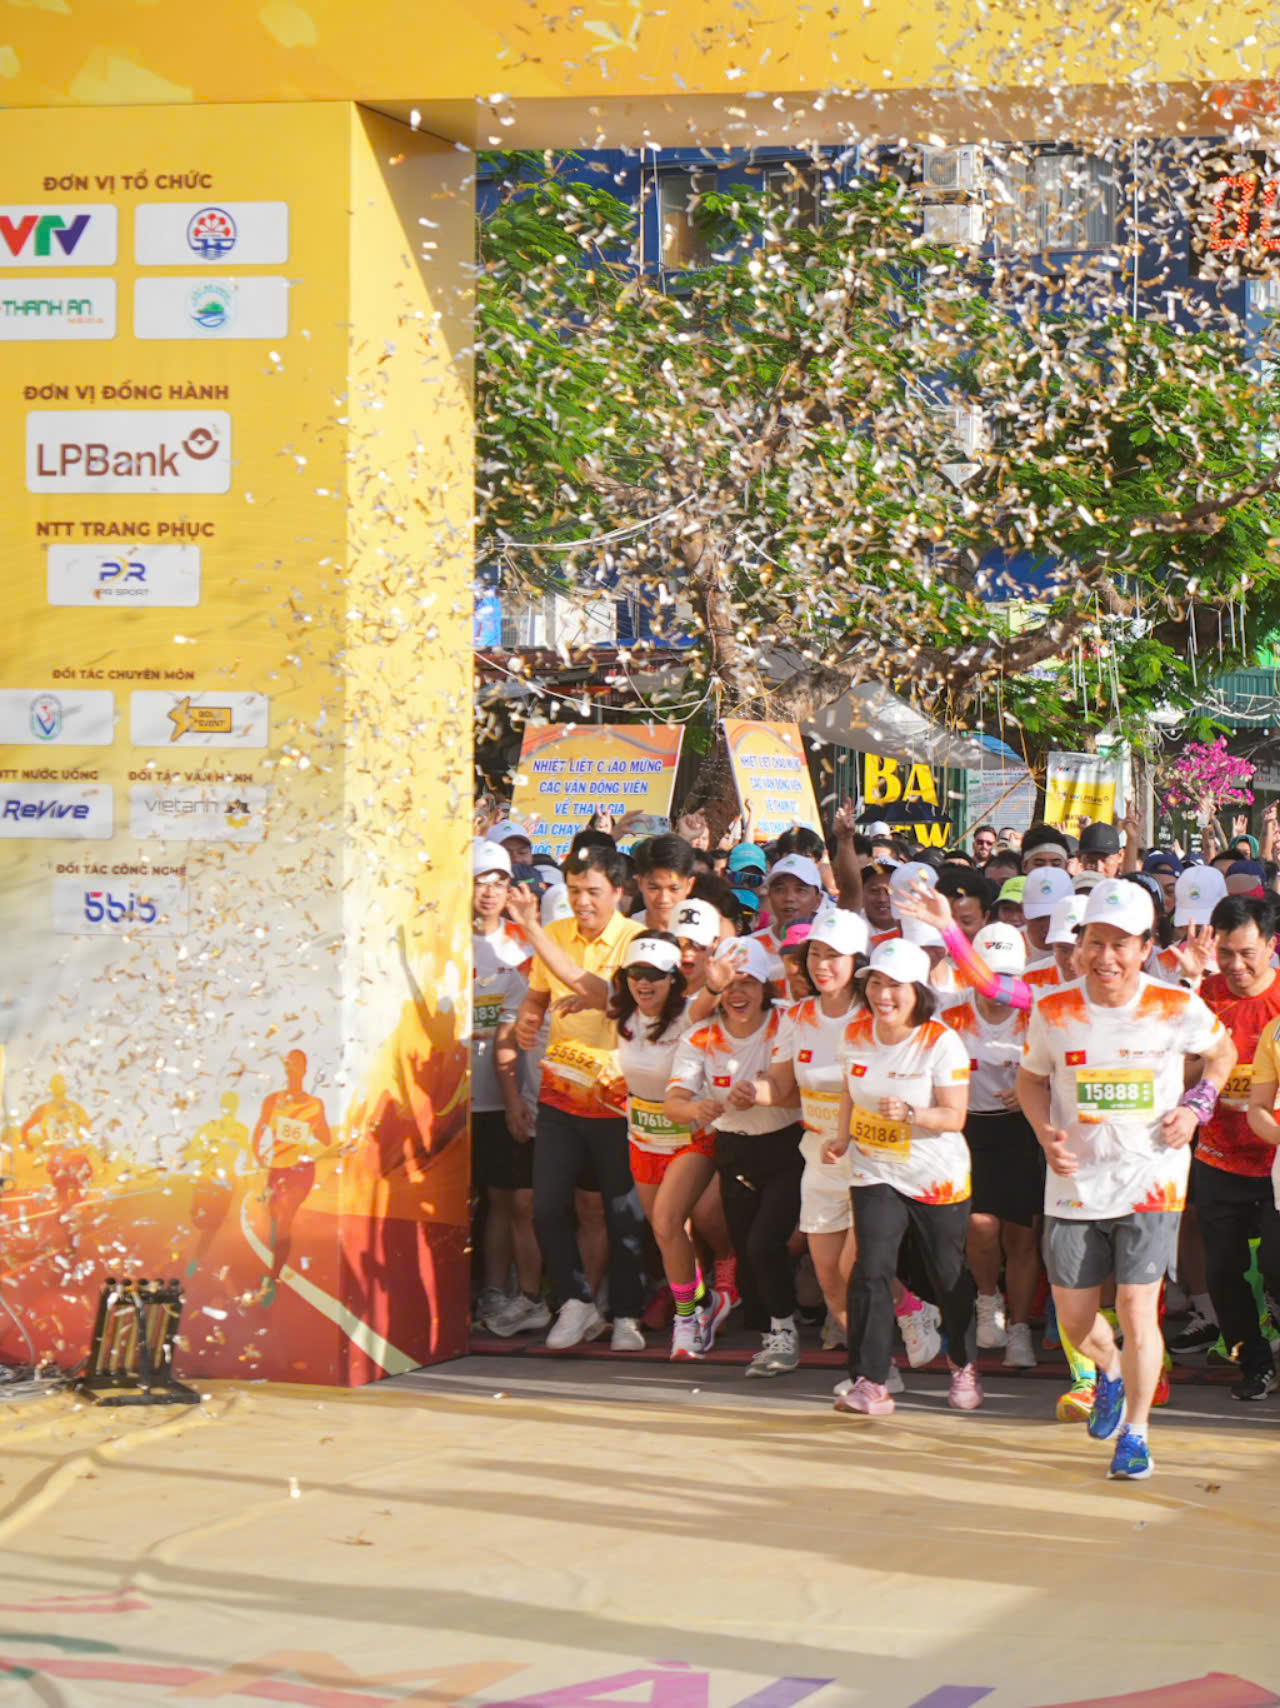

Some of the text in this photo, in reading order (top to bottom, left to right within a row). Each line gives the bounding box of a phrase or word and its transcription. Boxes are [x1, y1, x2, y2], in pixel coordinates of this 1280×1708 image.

[43, 169, 213, 194] ĐƠN VỊ TỔ CHỨC
[0, 214, 91, 256] VTV
[24, 380, 229, 404] ĐƠN VỊ ĐỒNG HÀNH
[37, 443, 180, 477] LPBank
[36, 521, 216, 541] NTT TRANG PHỤC
[80, 668, 104, 679] TÁC
[108, 668, 160, 680] CHUYÊN
[164, 667, 195, 680] MÔN
[597, 757, 627, 773] CÀO
[540, 778, 561, 793] CÁC
[1085, 1083, 1139, 1101] 15888
[856, 1121, 898, 1144] 52186
